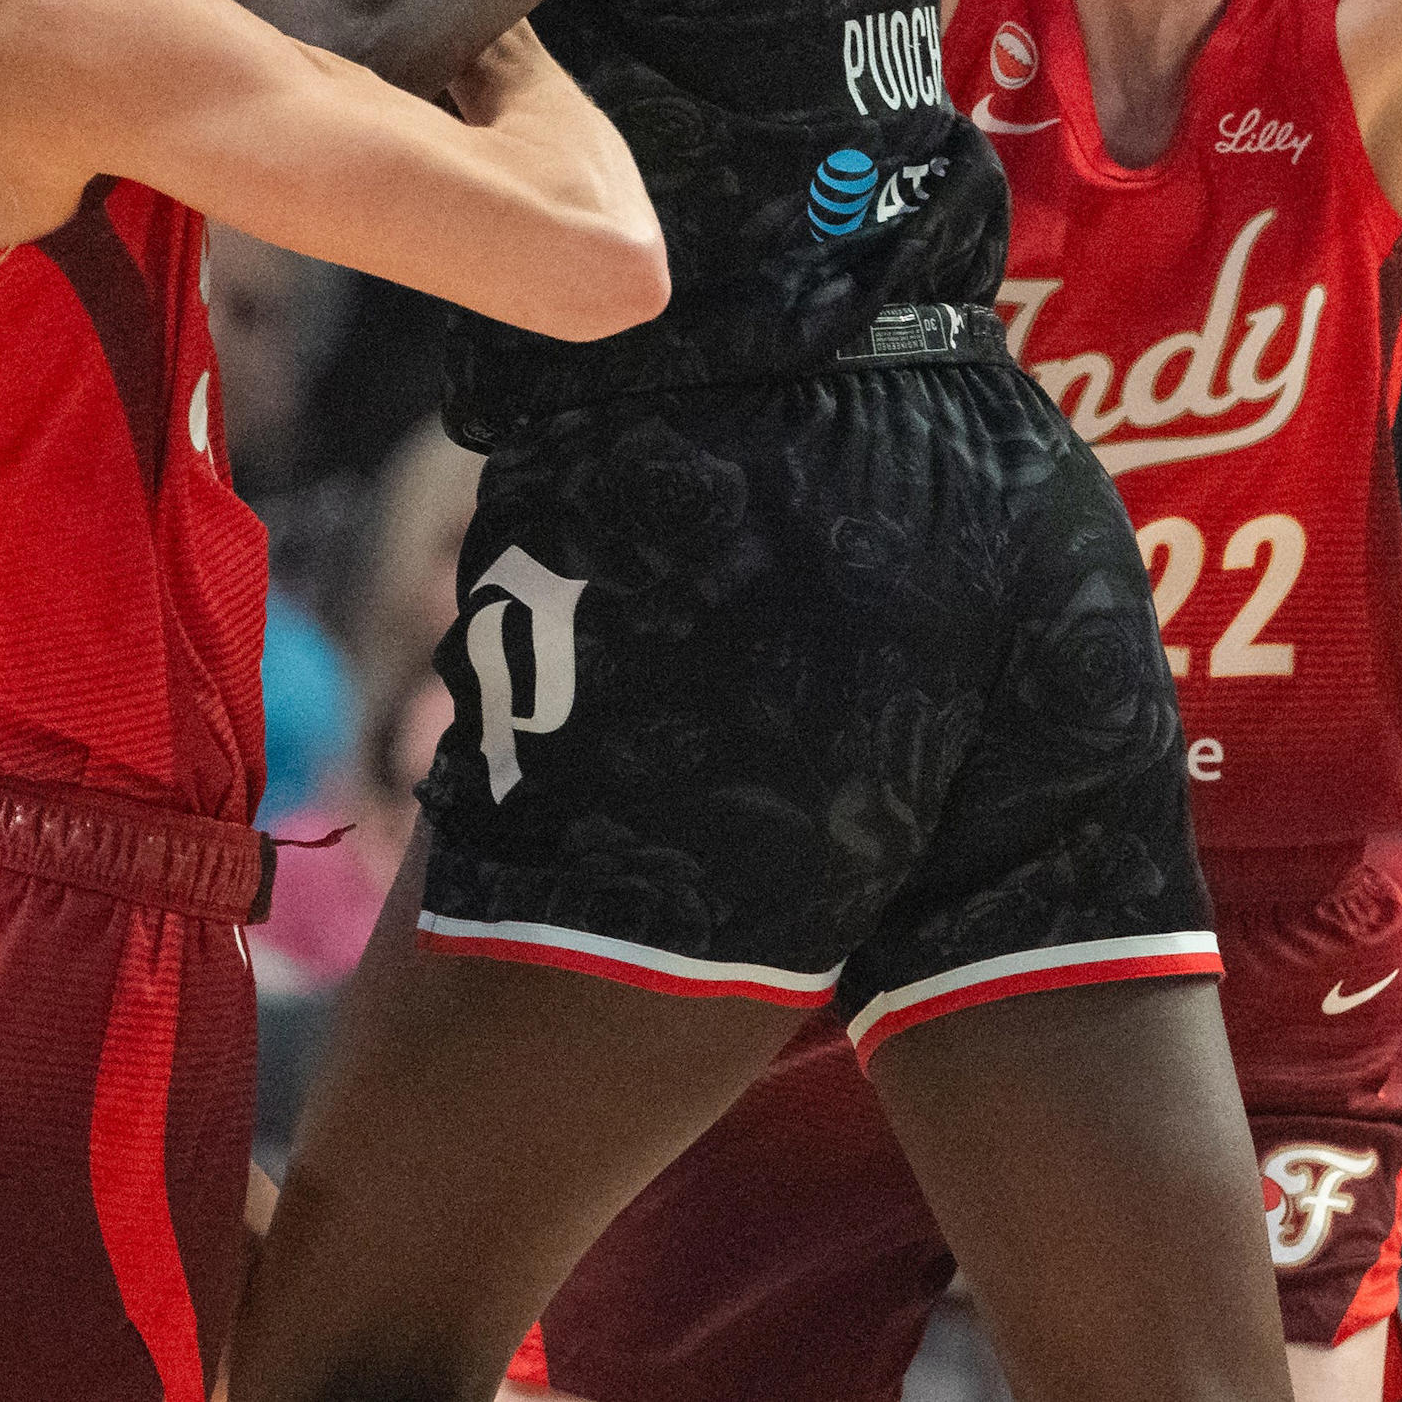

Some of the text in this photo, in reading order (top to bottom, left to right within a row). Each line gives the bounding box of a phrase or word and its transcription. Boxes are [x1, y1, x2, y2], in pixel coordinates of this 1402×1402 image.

[843, 5, 942, 116] PUOCH
[1214, 107, 1313, 165] Lilly
[1136, 513, 1307, 678] 22
